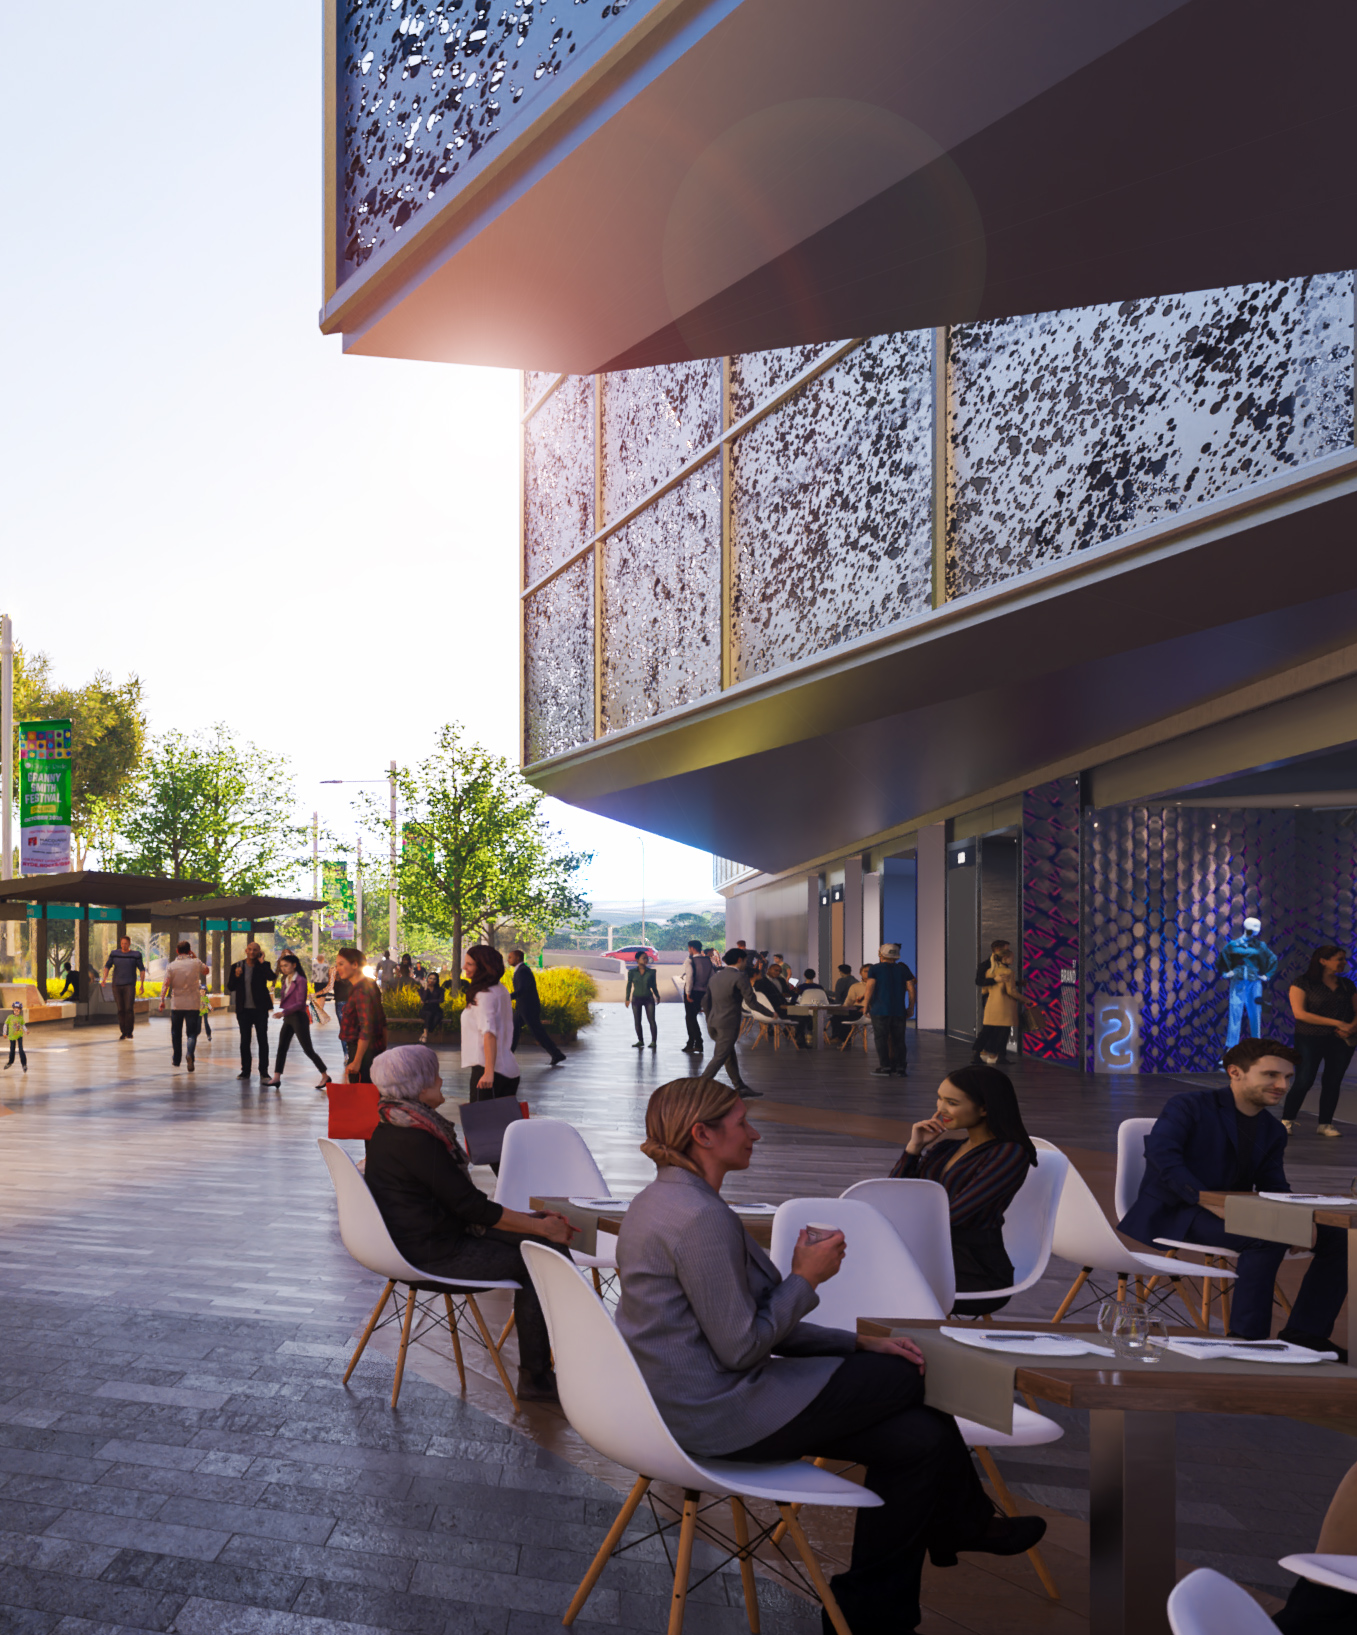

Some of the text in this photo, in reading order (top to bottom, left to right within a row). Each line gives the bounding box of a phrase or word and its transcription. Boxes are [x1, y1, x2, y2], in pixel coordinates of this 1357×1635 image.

[28, 772, 61, 782] GRANNY
[31, 783, 56, 792] SMITH
[25, 792, 62, 804] FESTIVAL
